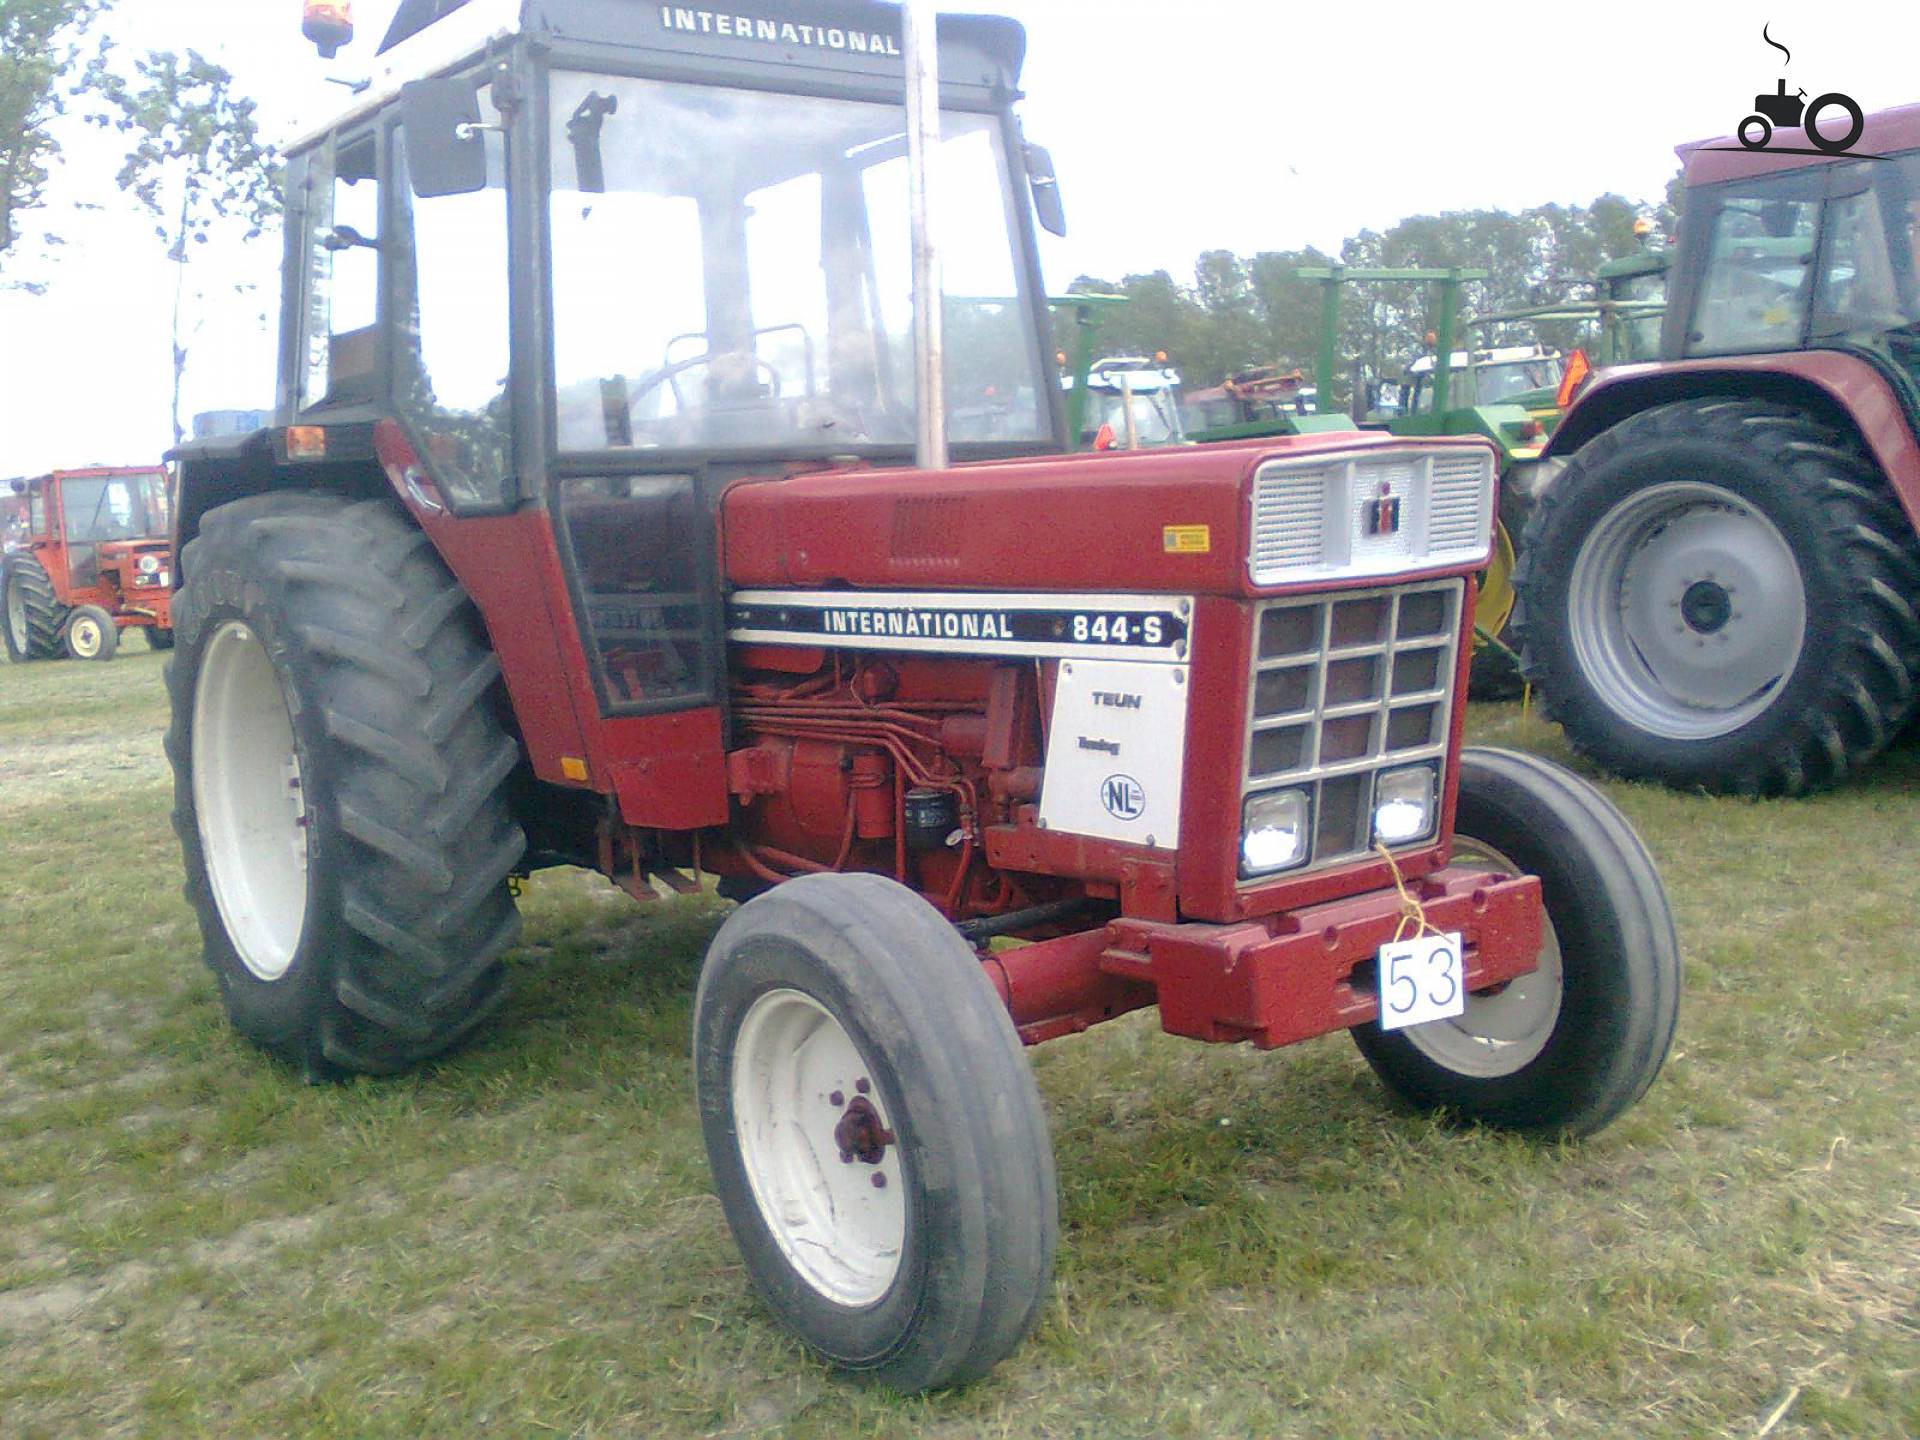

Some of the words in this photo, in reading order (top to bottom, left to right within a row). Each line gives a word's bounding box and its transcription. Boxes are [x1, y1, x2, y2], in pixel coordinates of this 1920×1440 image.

[662, 6, 900, 55] INTERNATIONAL
[823, 610, 1014, 638] INTERNATIONAL
[1390, 947, 1456, 1013] 53
